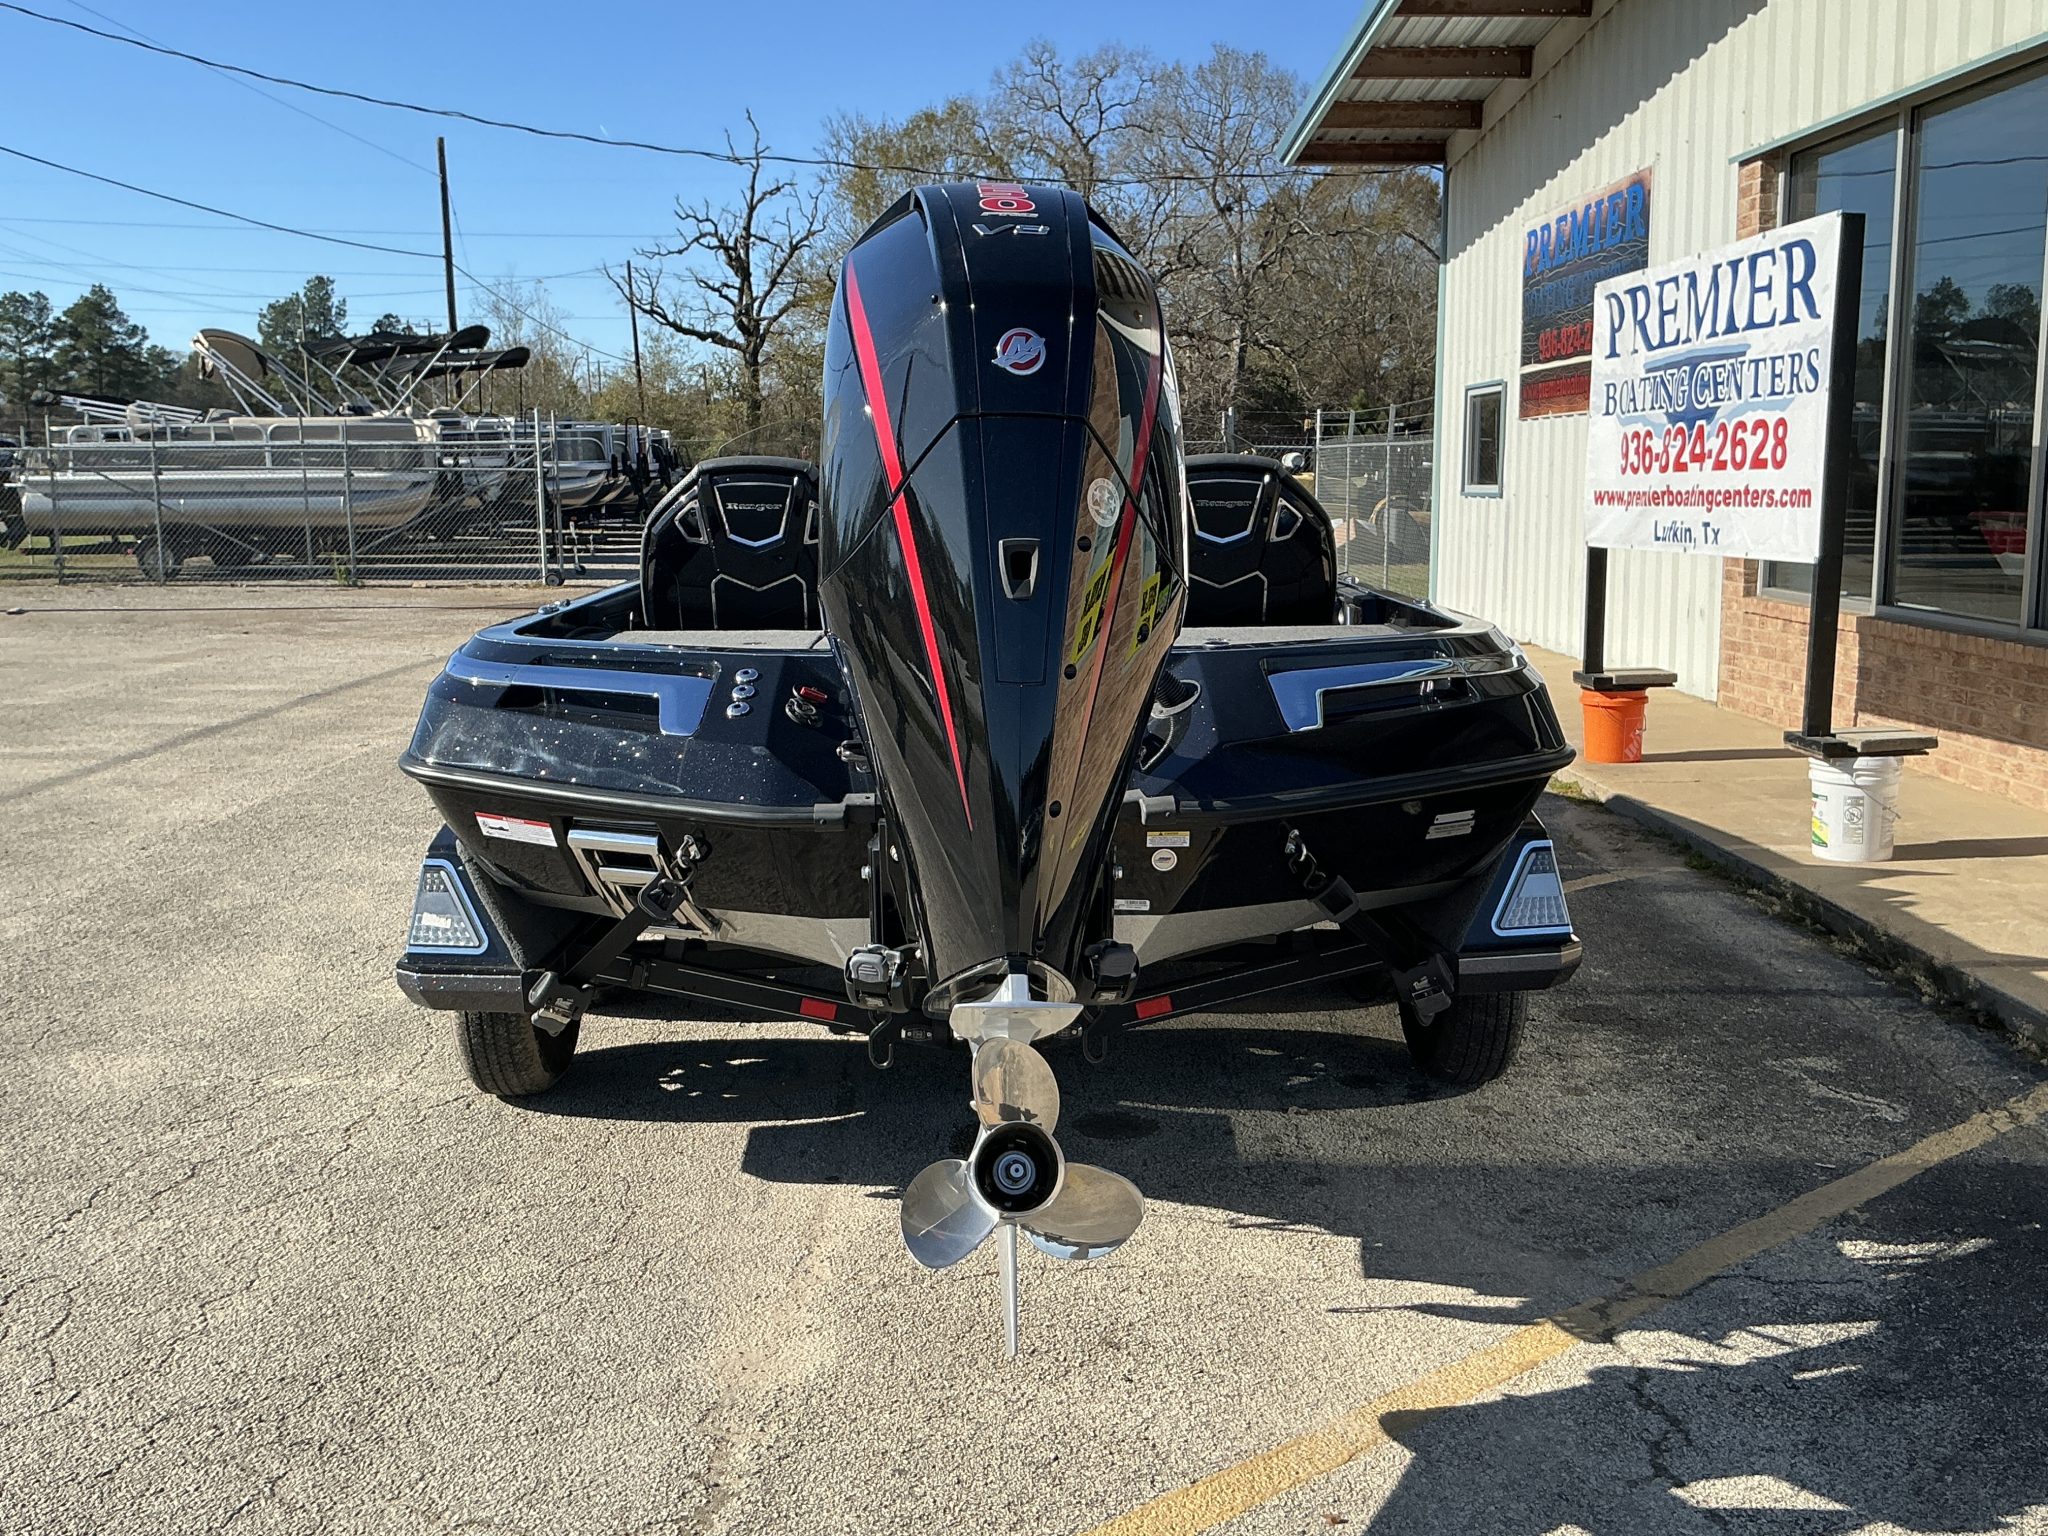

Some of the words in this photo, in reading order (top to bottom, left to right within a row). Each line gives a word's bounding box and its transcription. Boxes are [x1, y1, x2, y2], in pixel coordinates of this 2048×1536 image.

[1525, 183, 1645, 278] PREMIER
[1604, 238, 1821, 360] PREMIER
[1602, 369, 1690, 417] BOATING
[1696, 348, 1820, 406] CENTERS
[1620, 417, 1788, 475] 936-824-2628
[725, 502, 783, 512] Ranger
[1594, 484, 1812, 513] www.premierboatingcenters.com
[1654, 520, 1697, 546] Lufkin,
[1702, 521, 1721, 545] Tx
